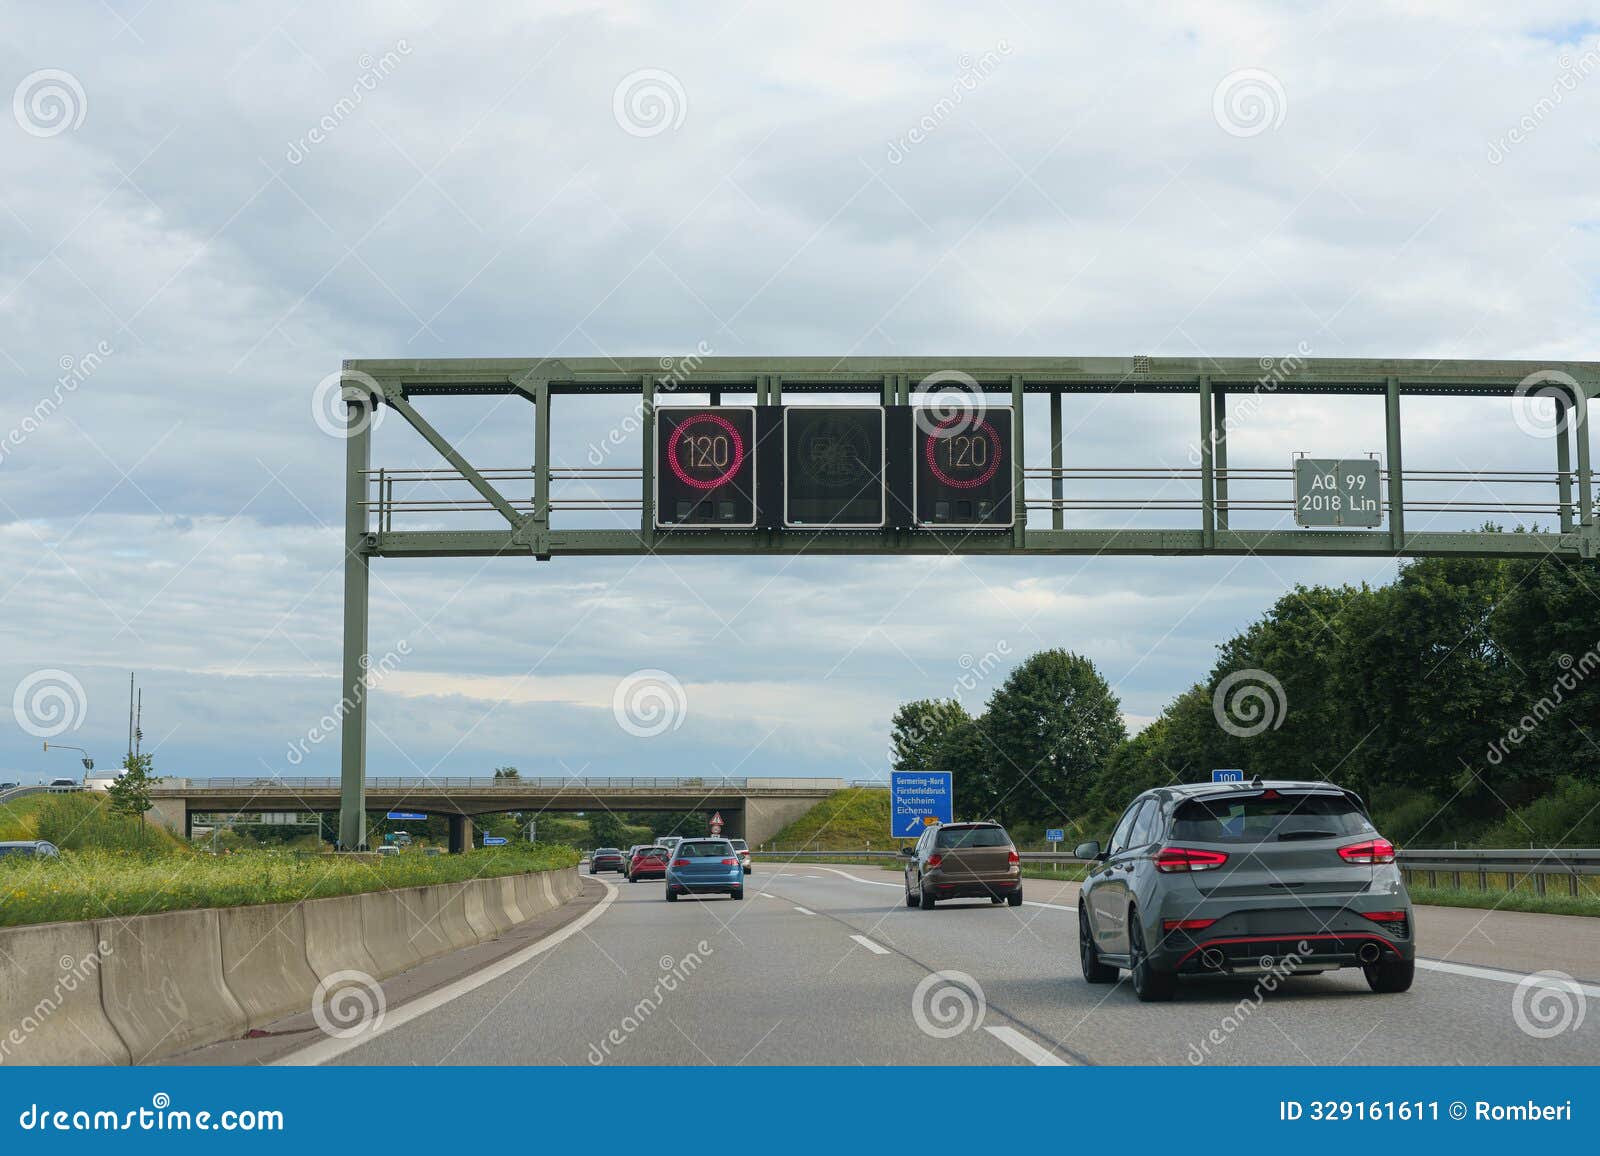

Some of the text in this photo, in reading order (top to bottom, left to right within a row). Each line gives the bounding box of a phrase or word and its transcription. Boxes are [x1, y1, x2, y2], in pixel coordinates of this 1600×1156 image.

[684, 436, 728, 467] 120
[941, 436, 987, 467] 120
[1312, 474, 1366, 490] AQ 99
[1302, 495, 1376, 511] 2018 Lin
[896, 777, 944, 786] Germering-Nord
[896, 796, 936, 805] Puchheim
[897, 806, 933, 815] Eichenau
